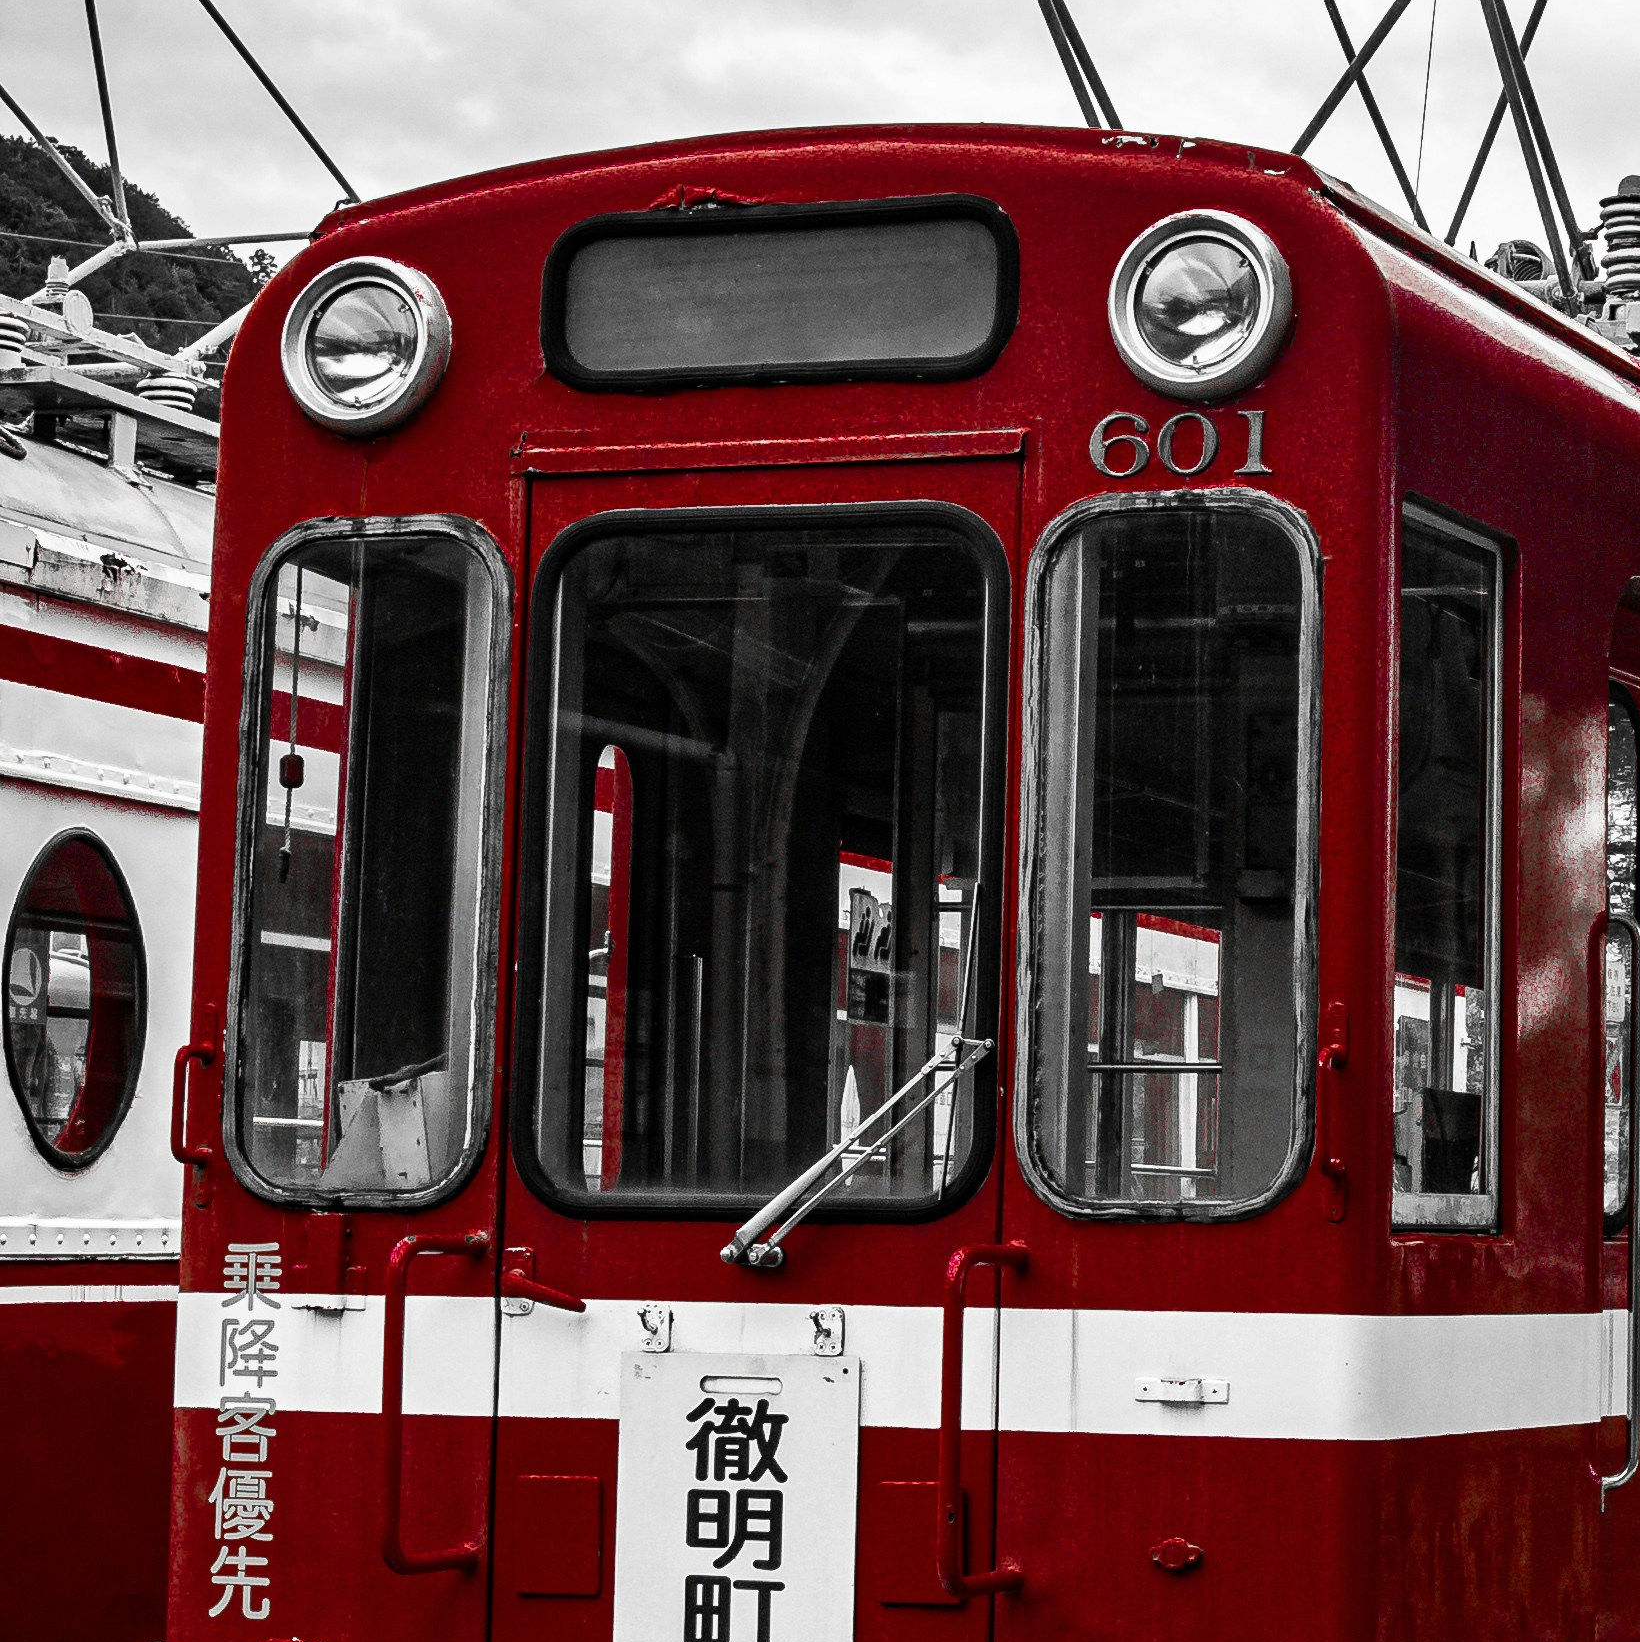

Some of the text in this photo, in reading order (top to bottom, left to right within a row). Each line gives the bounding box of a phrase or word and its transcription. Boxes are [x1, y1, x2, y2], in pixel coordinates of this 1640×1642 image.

[1089, 411, 1273, 478] 601
[208, 1241, 282, 1619] 乗降客優先
